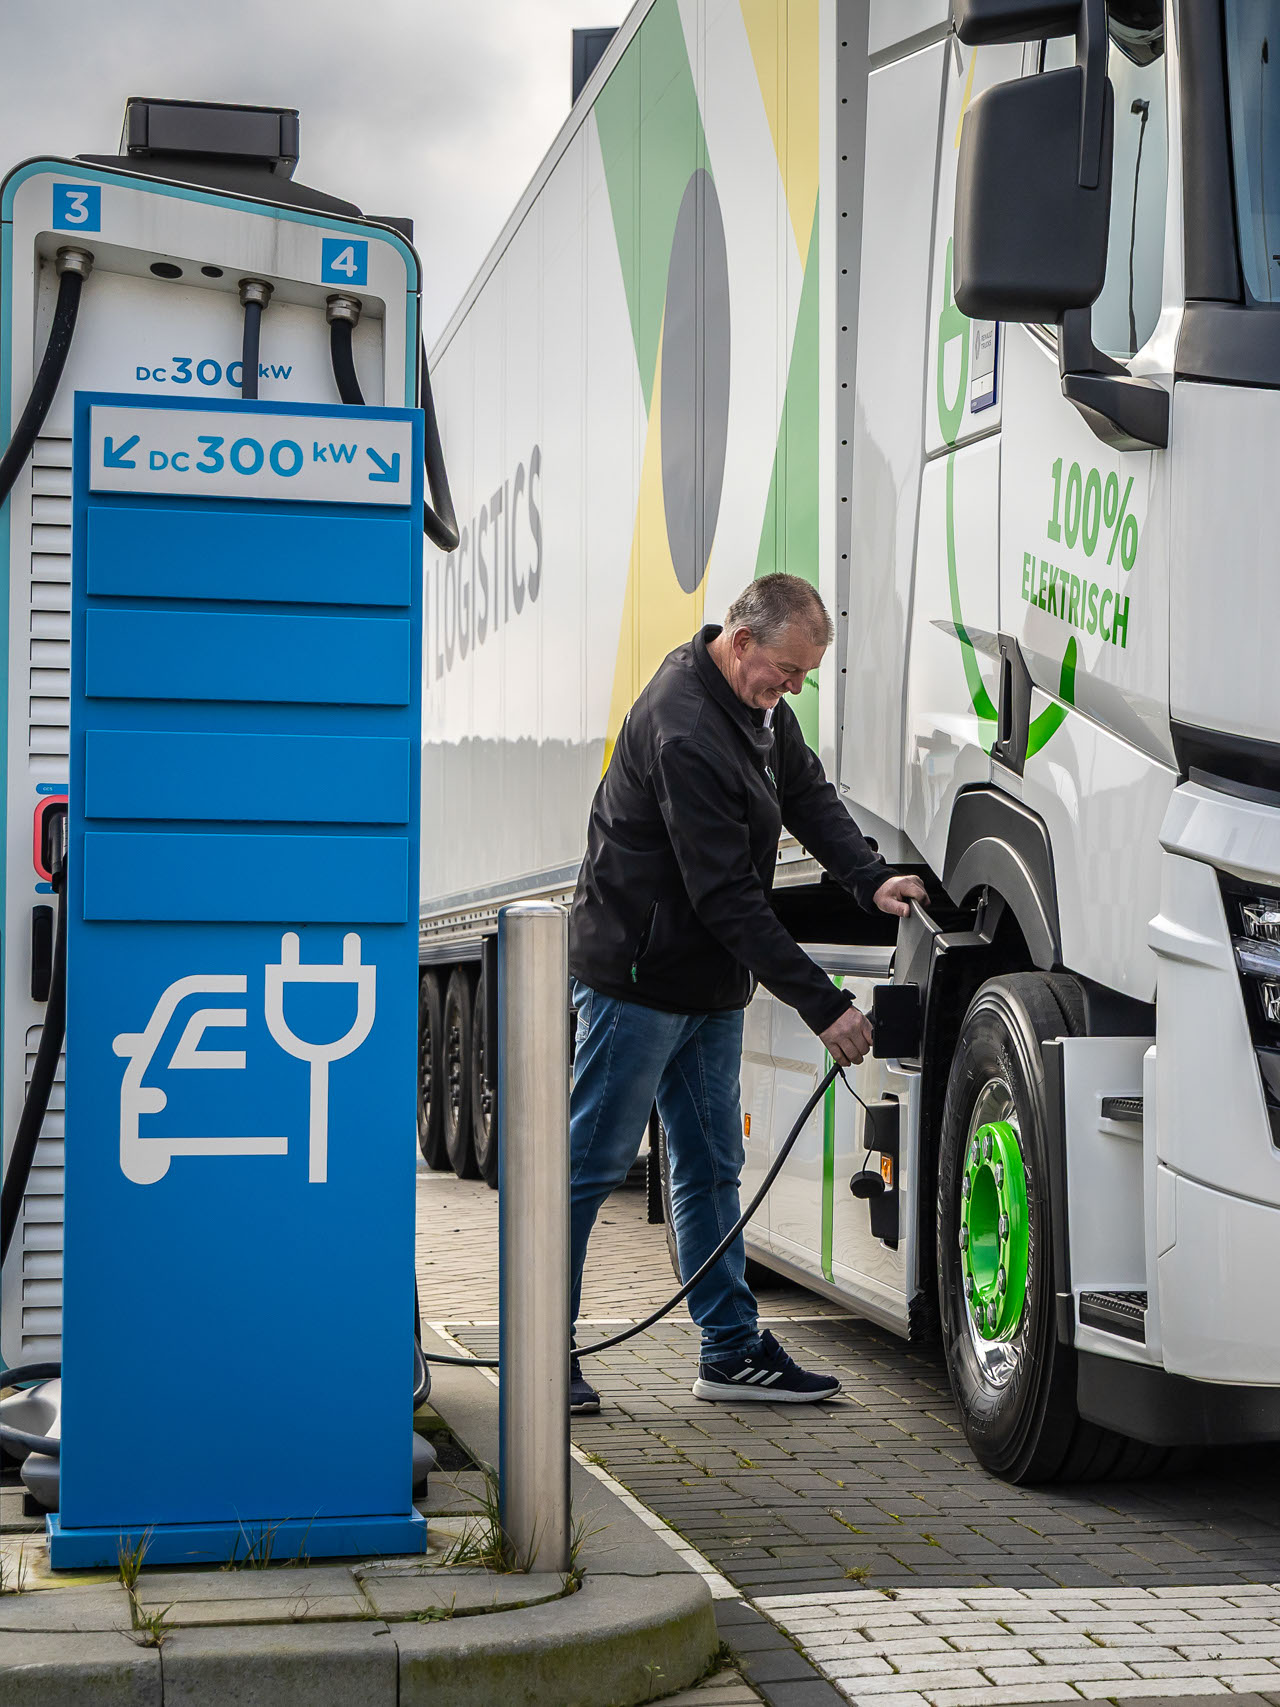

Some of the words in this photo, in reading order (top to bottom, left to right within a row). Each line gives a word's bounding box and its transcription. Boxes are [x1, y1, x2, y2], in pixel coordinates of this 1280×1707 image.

[64, 191, 89, 224] 3
[330, 246, 358, 278] 4
[136, 366, 167, 382] DC
[258, 363, 293, 380] kW
[149, 450, 190, 472] DC
[196, 435, 304, 478] 300
[312, 441, 358, 464] kW
[1047, 457, 1139, 571] 100%
[435, 444, 542, 681] LOGISTICS
[1021, 551, 1130, 649] ELEKTRISCH
